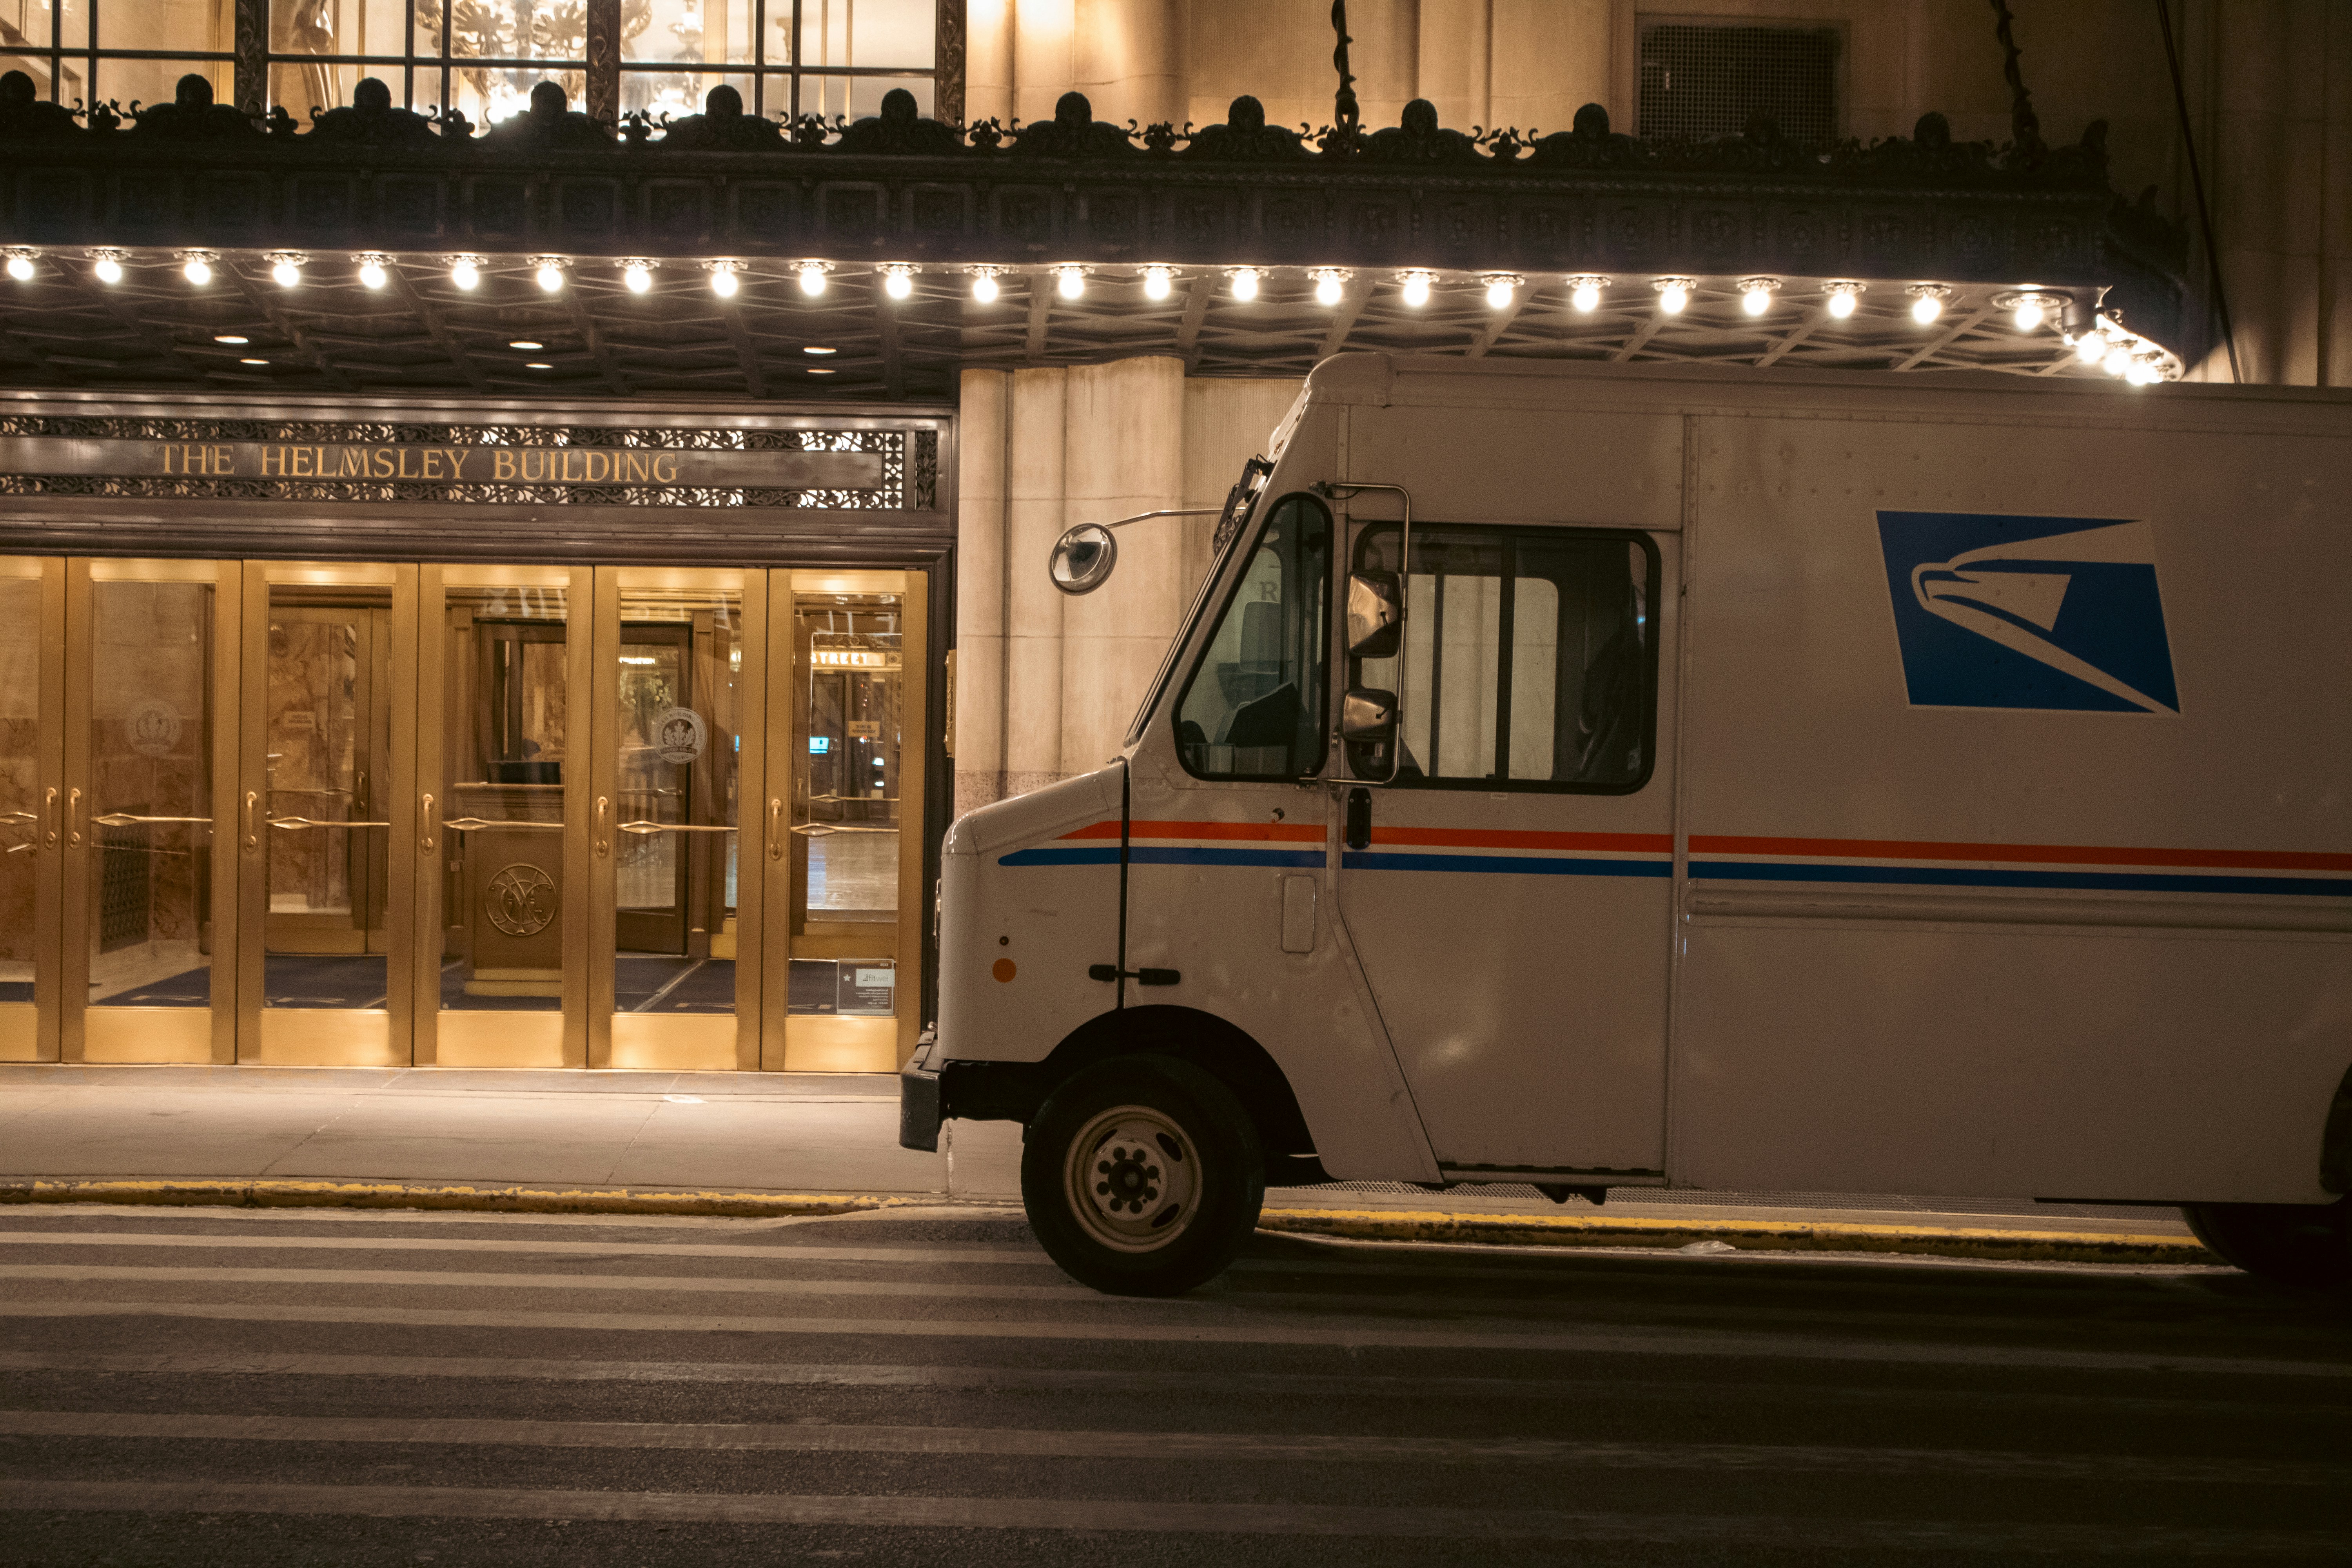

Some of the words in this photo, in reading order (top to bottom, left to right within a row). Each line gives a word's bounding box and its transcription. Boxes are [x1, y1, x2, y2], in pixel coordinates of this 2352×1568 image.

[159, 444, 235, 475] THE
[260, 445, 469, 479] HELMSLEY
[493, 450, 678, 483] BUILDING
[810, 652, 868, 664] STREET
